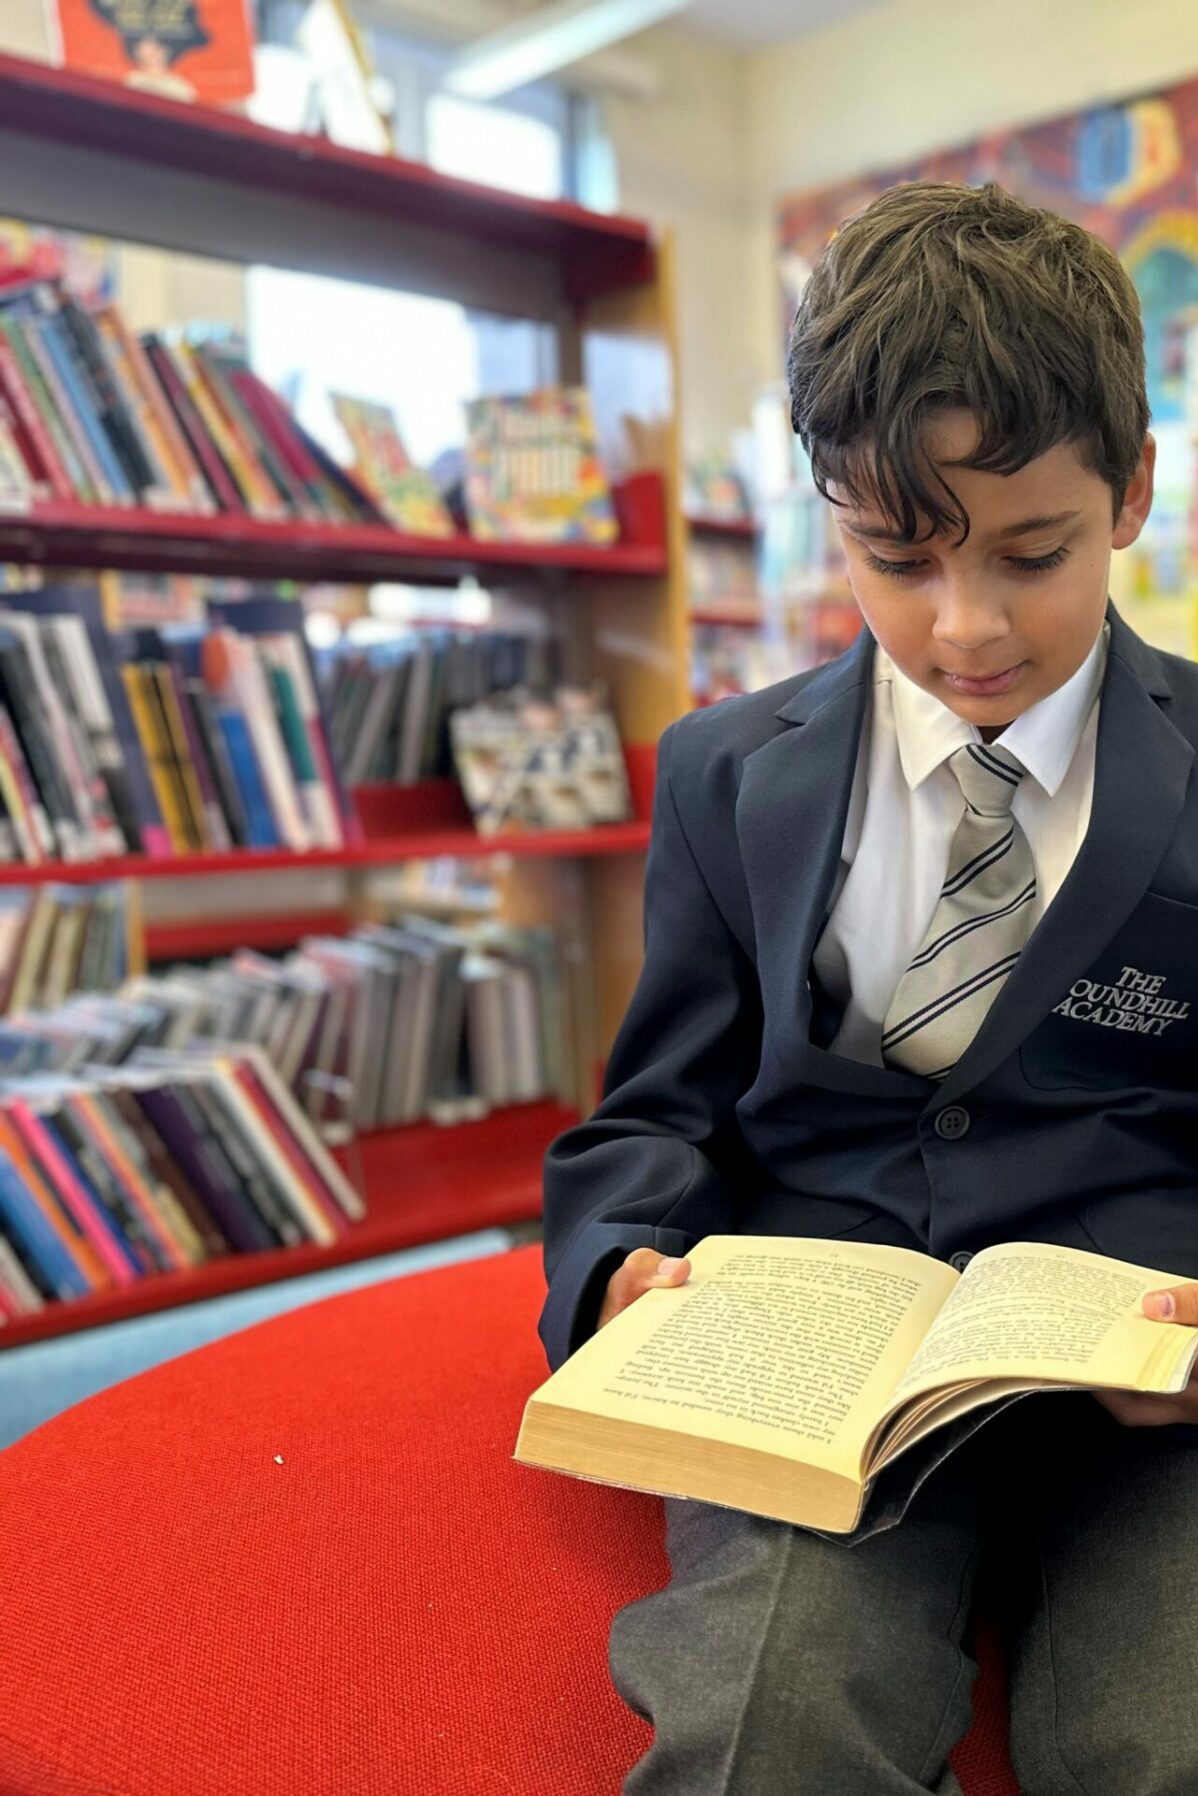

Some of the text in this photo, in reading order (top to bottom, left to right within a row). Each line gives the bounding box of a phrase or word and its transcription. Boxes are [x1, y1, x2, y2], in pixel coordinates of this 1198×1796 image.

[1069, 979, 1191, 1019] OUNDHILL
[1115, 966, 1167, 994] THE
[1051, 997, 1174, 1036] ACADEMY
